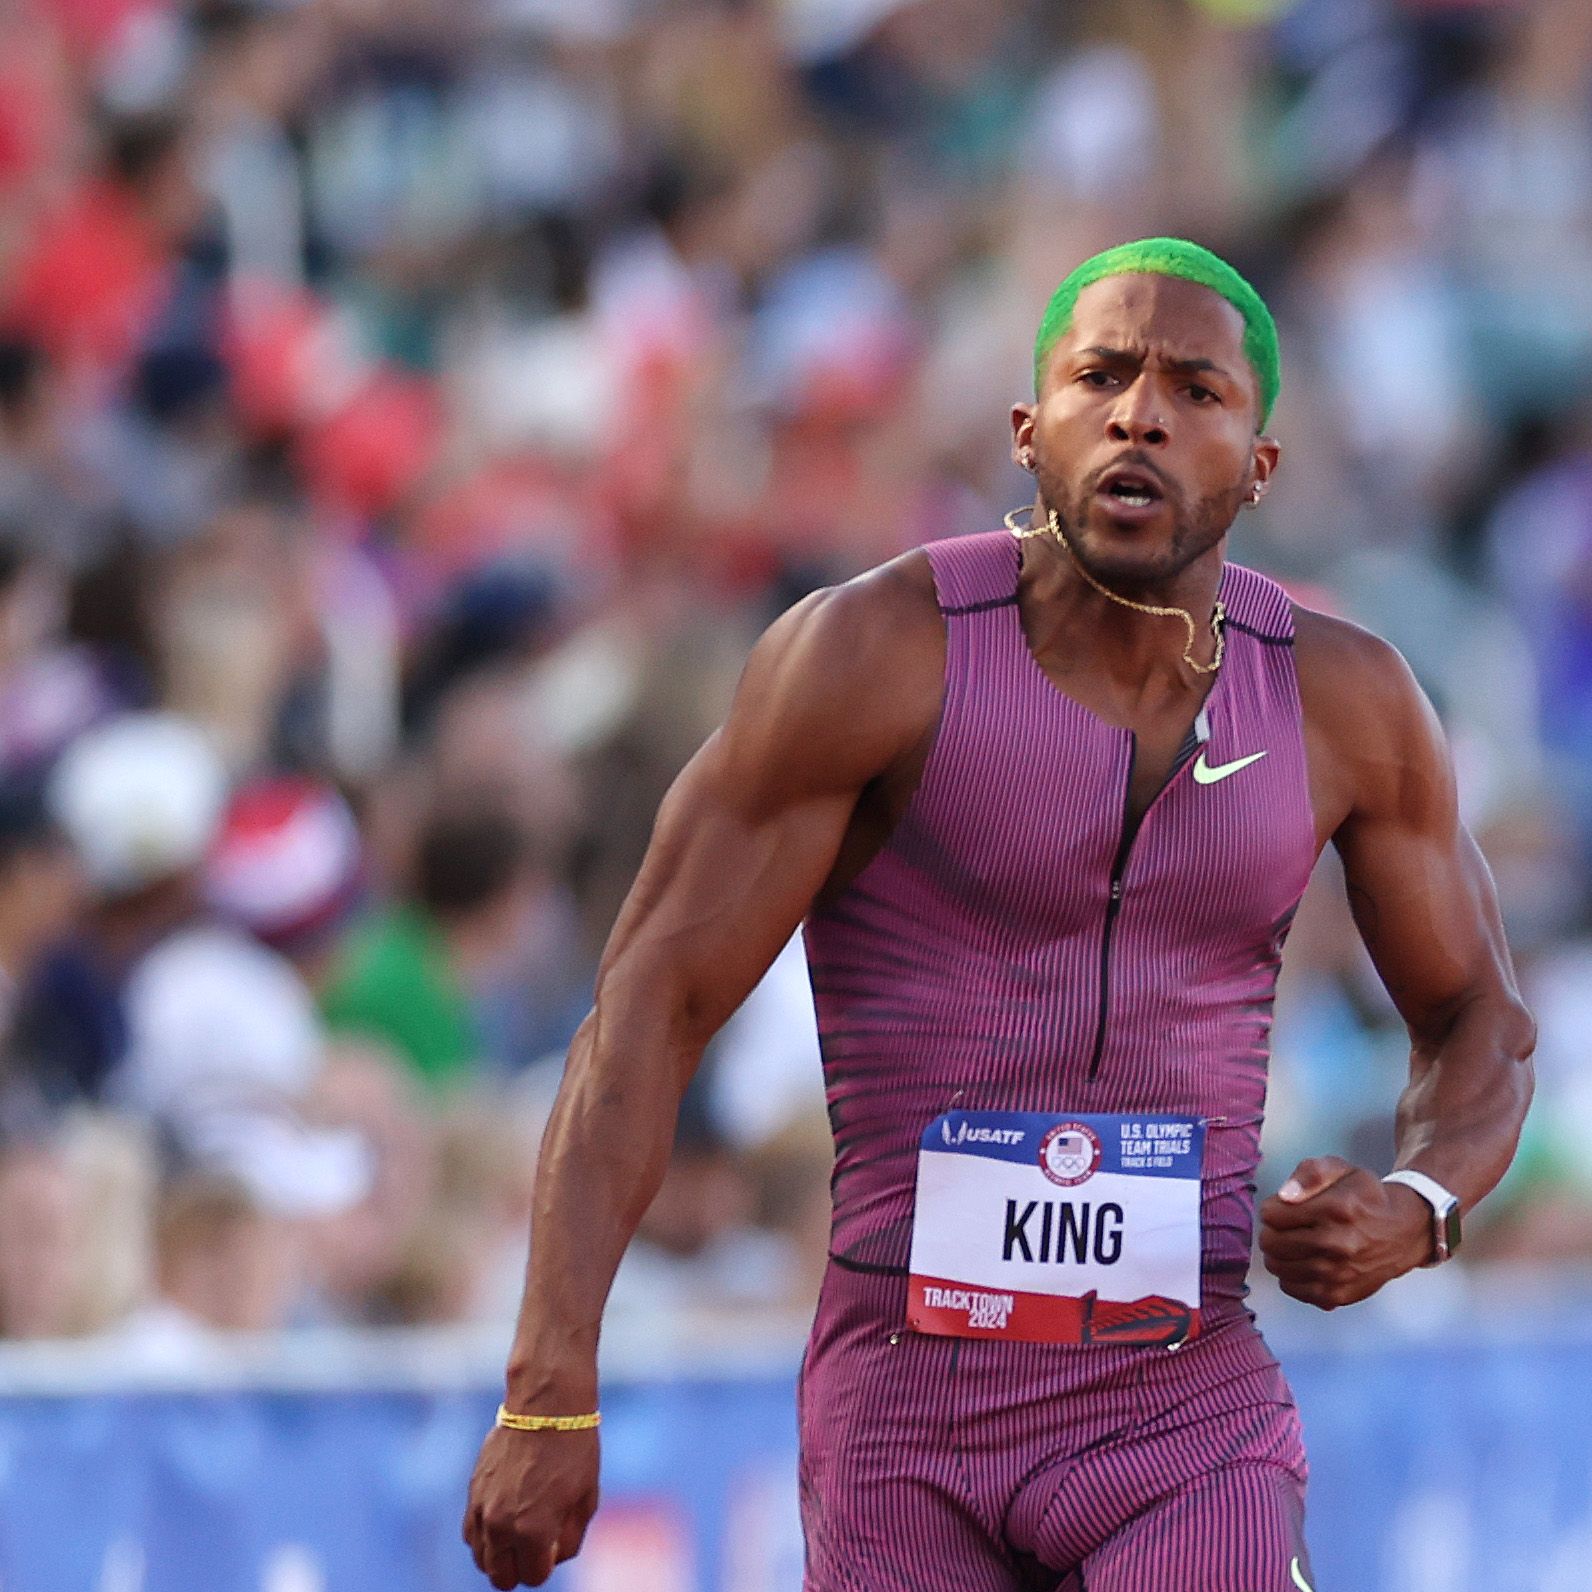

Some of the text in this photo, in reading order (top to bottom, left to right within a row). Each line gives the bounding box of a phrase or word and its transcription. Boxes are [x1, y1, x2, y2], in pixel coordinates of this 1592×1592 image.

[966, 1128, 1025, 1146] USATF
[1146, 1123, 1193, 1139] OLYMPIC
[1120, 1139, 1191, 1156] TEAM TRIALS
[1002, 1199, 1124, 1265] KING
[923, 1287, 1014, 1315] TRACKTOWN
[968, 1309, 1008, 1330] 2024
